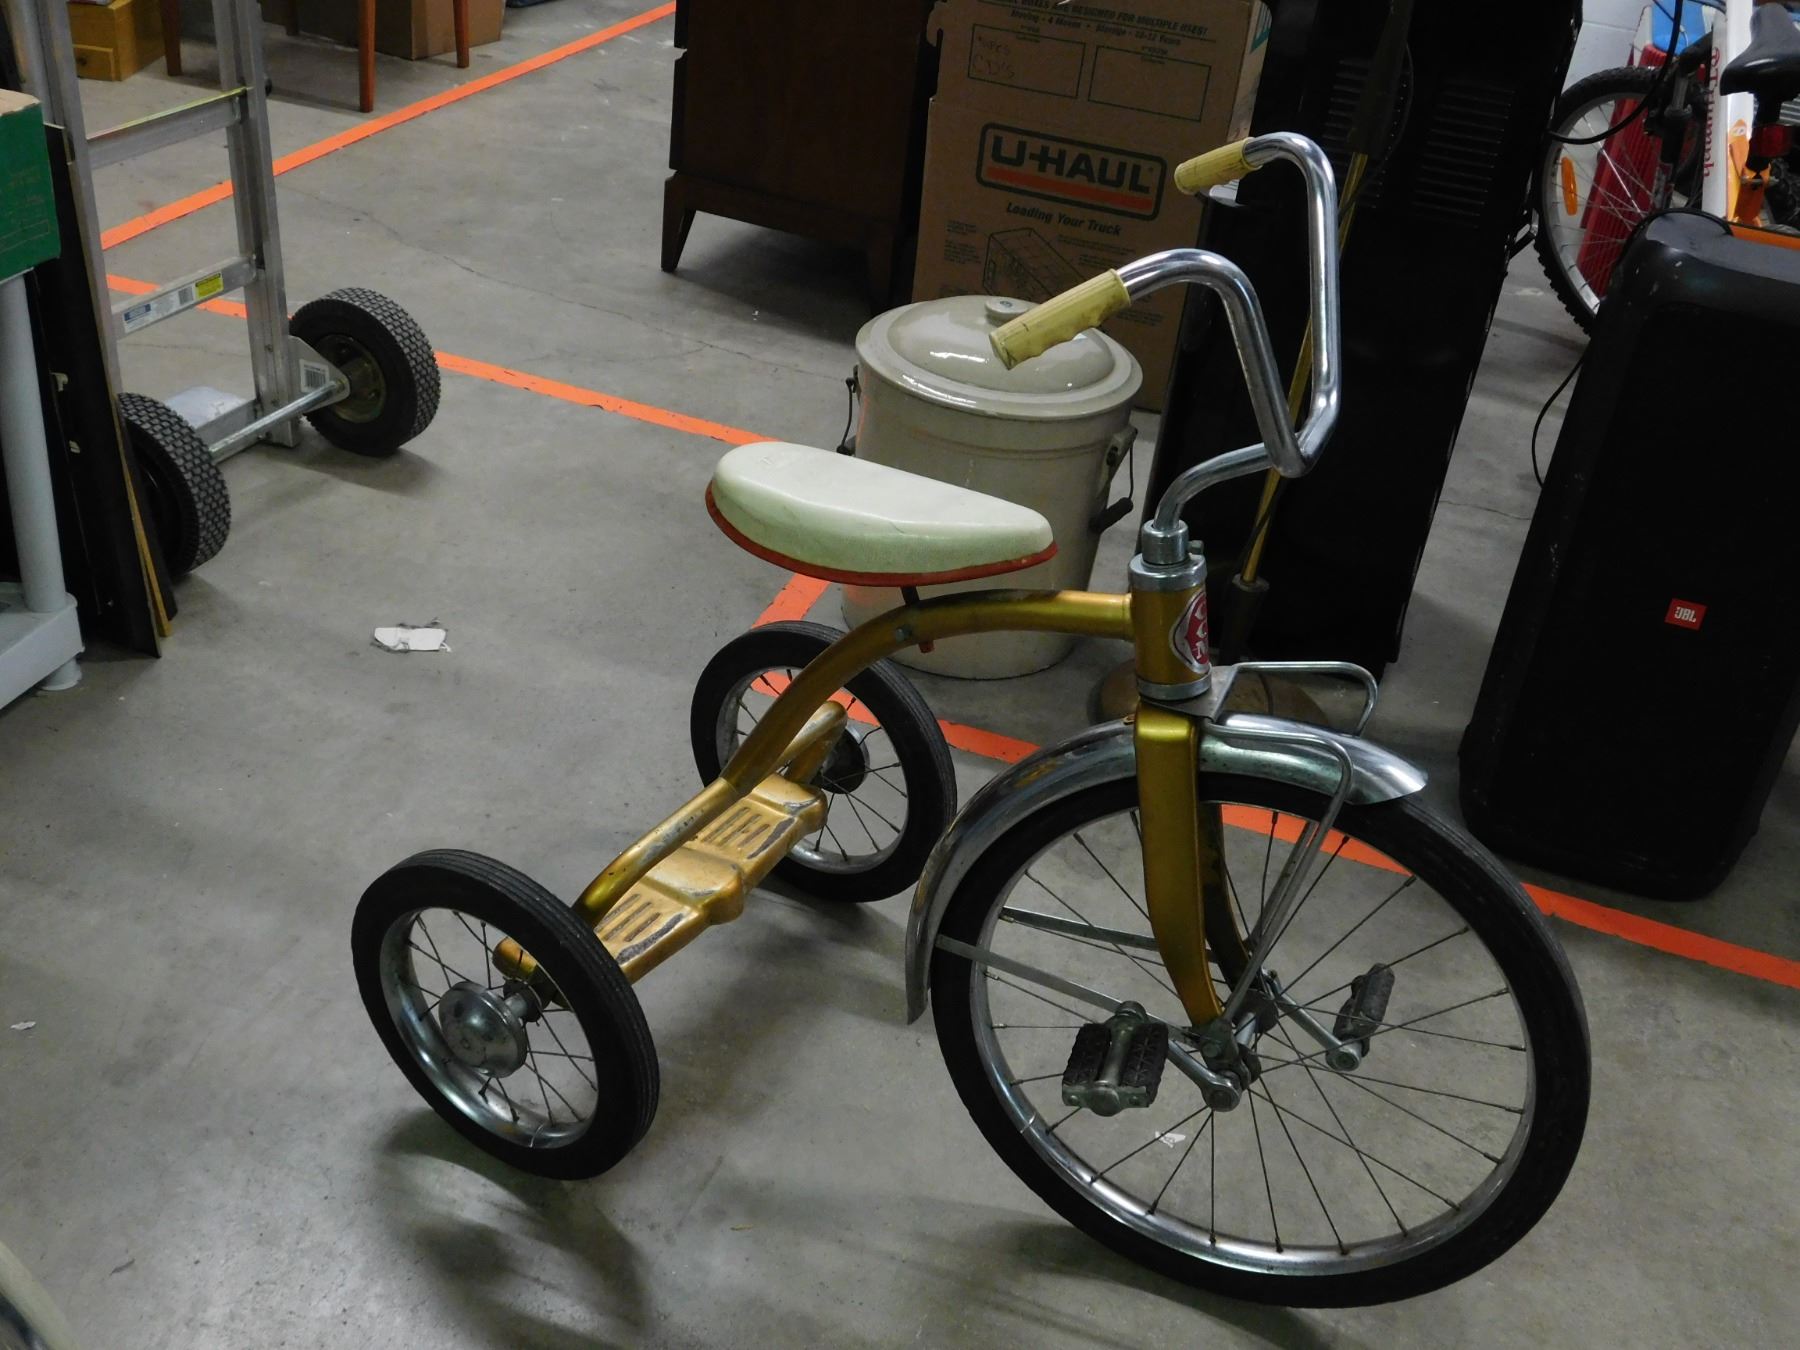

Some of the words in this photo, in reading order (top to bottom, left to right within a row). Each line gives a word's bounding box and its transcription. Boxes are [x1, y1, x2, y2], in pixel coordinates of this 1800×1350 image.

[1010, 10, 1039, 24] Moving
[1072, 4, 1116, 20] DESIGNED
[1116, 12, 1136, 23] FOR
[1137, 15, 1180, 31] MULTIPLE
[991, 135, 1151, 194] U-HAUL
[1006, 202, 1053, 225] Loading
[1057, 212, 1085, 230] Your
[1087, 219, 1122, 237] Truck
[1674, 606, 1697, 623] JBL
